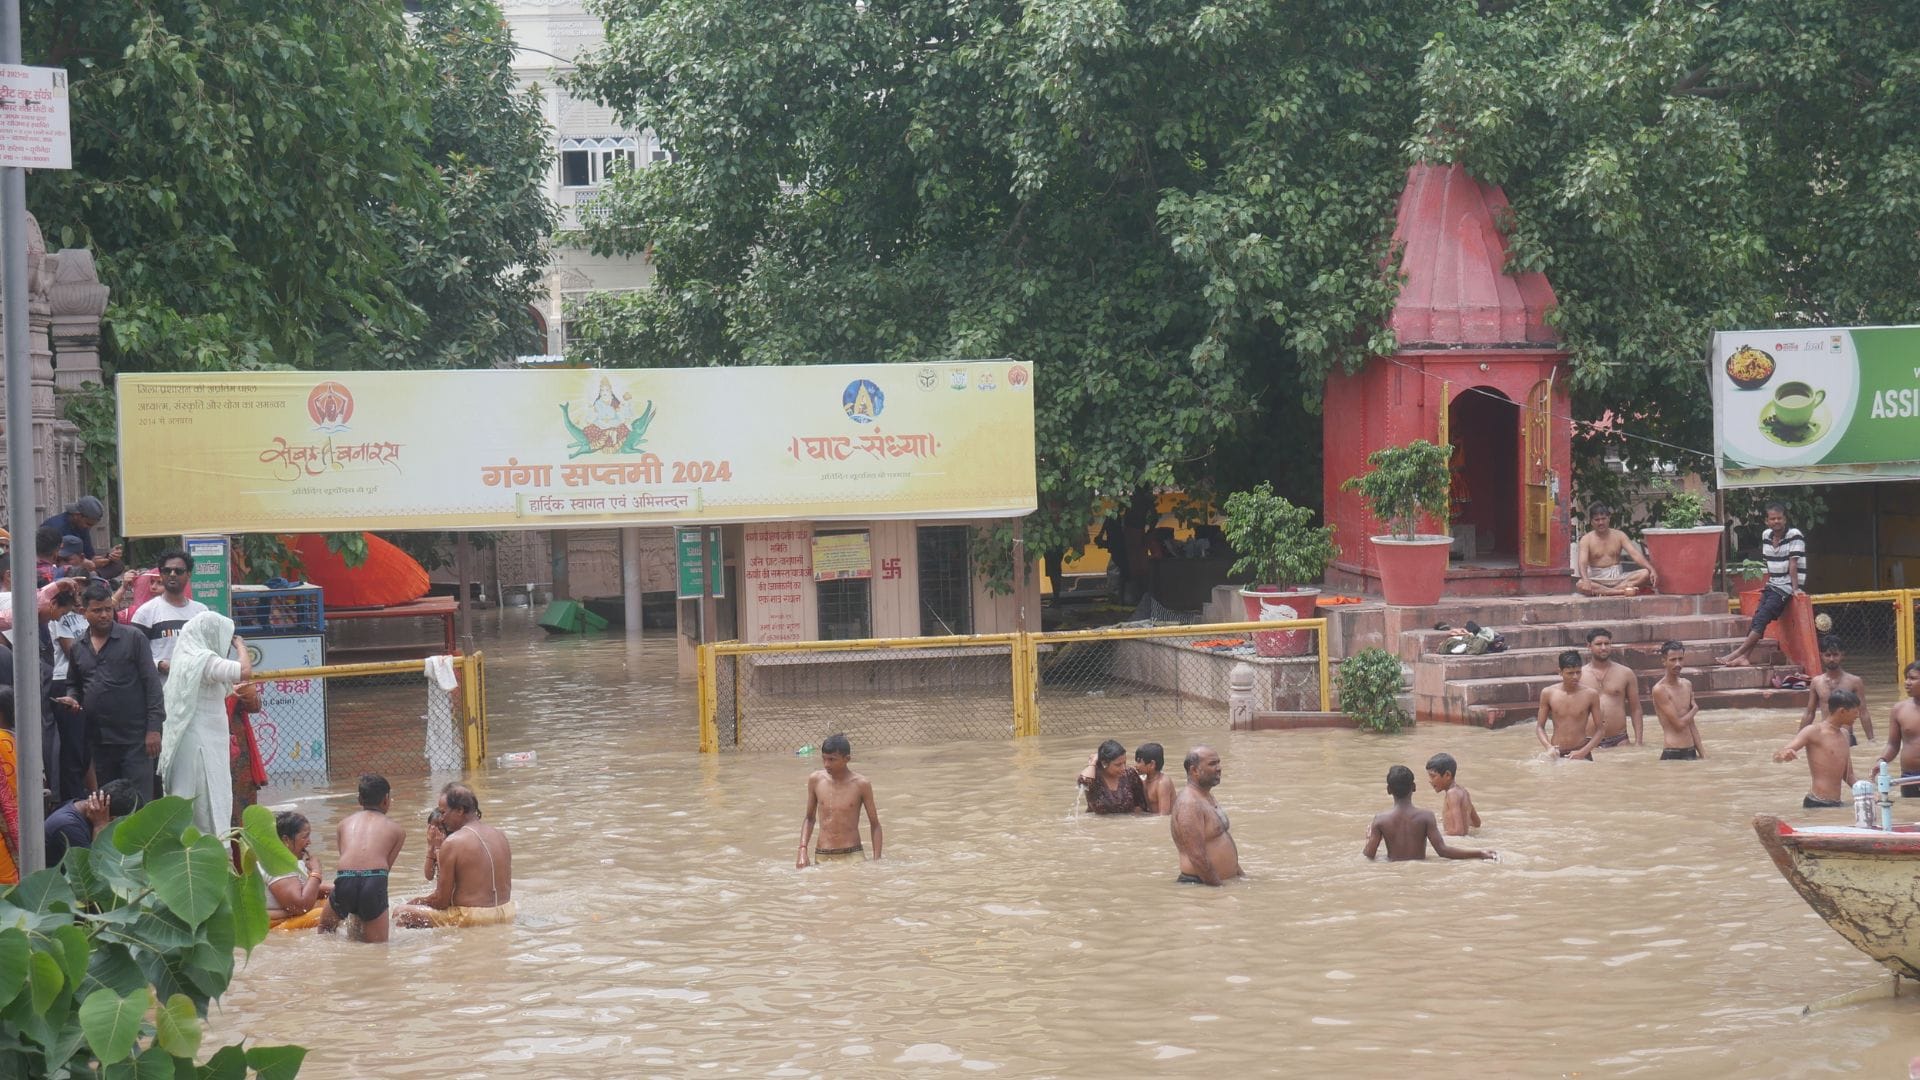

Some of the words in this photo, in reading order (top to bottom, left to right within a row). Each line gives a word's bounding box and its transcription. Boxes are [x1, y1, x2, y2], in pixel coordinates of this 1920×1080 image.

[174, 399, 204, 413] संस्कृति
[206, 399, 222, 410] और
[242, 400, 253, 409] का
[1871, 388, 1919, 419] ASSI
[481, 457, 553, 488] गंगा
[560, 453, 664, 487] सप्तमी
[671, 460, 733, 483] 2024
[528, 495, 565, 513] हार्दिक
[570, 497, 605, 511] स्वागत
[608, 493, 627, 509] एवं
[632, 494, 689, 510] अभिनन्दन
